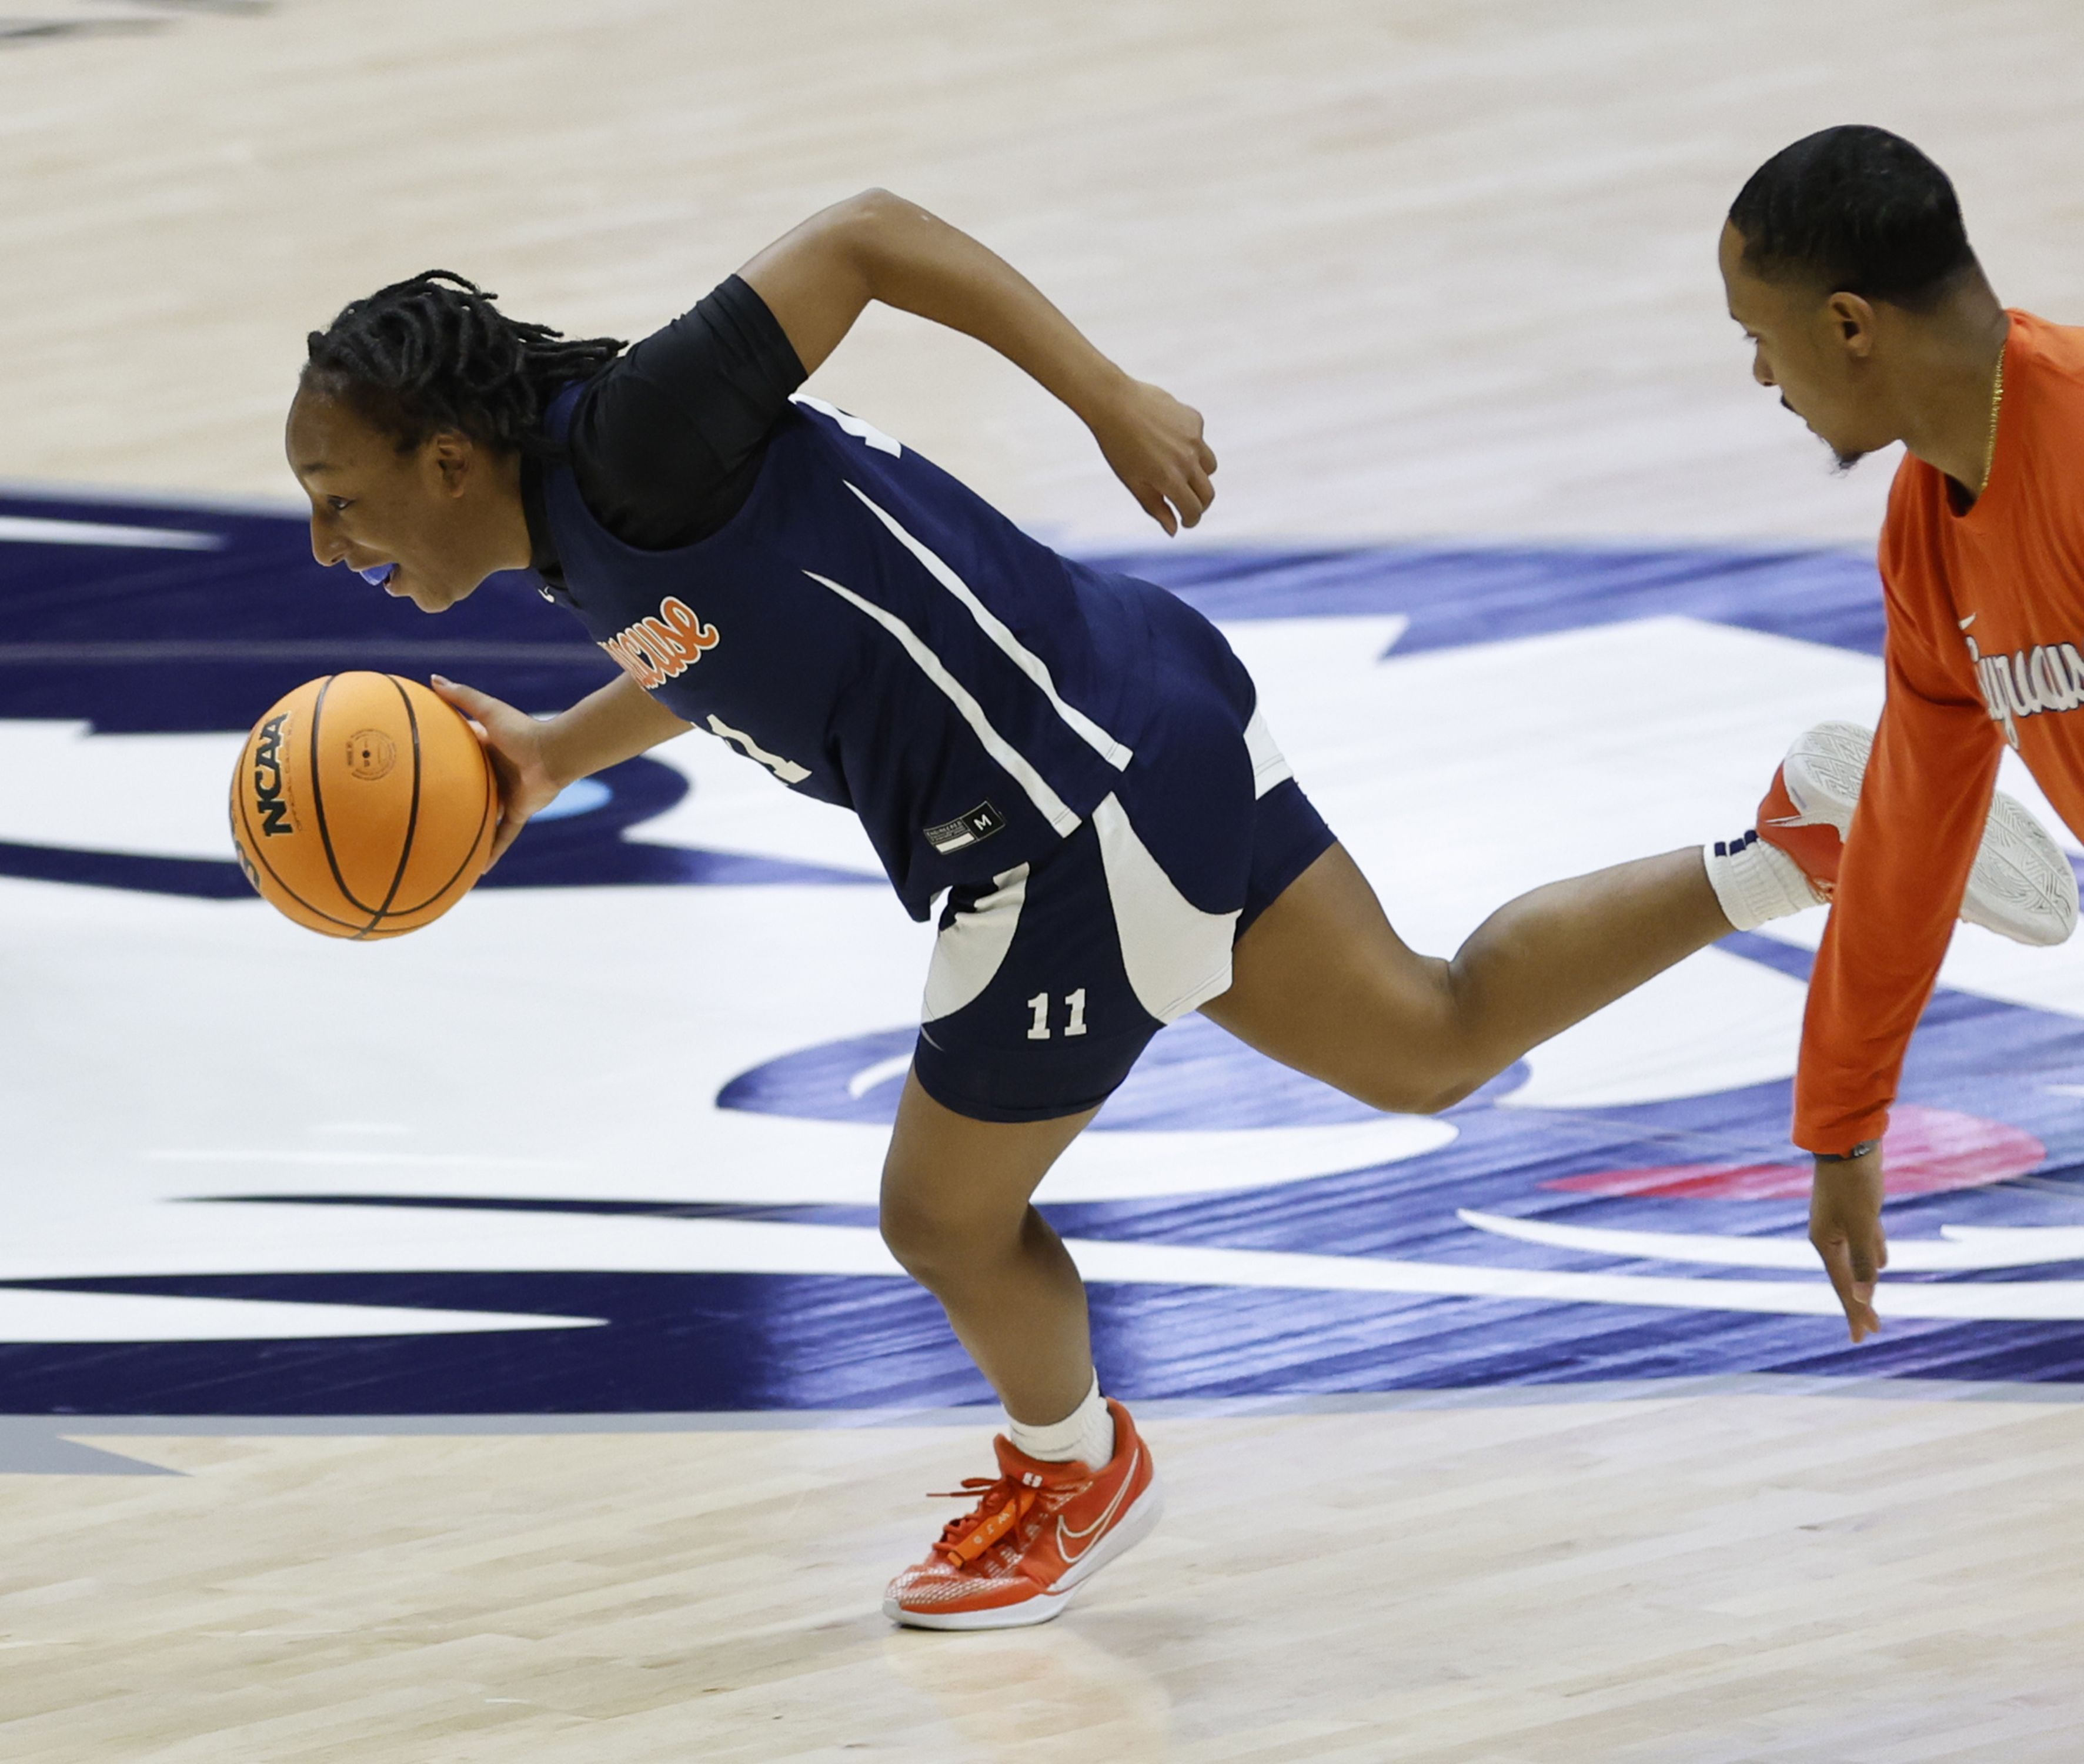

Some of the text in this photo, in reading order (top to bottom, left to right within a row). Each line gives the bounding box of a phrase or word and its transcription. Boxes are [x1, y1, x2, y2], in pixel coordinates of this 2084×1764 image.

[255, 710, 293, 837] NCAA
[973, 814, 992, 831] M
[1027, 988, 1087, 1040] 11
